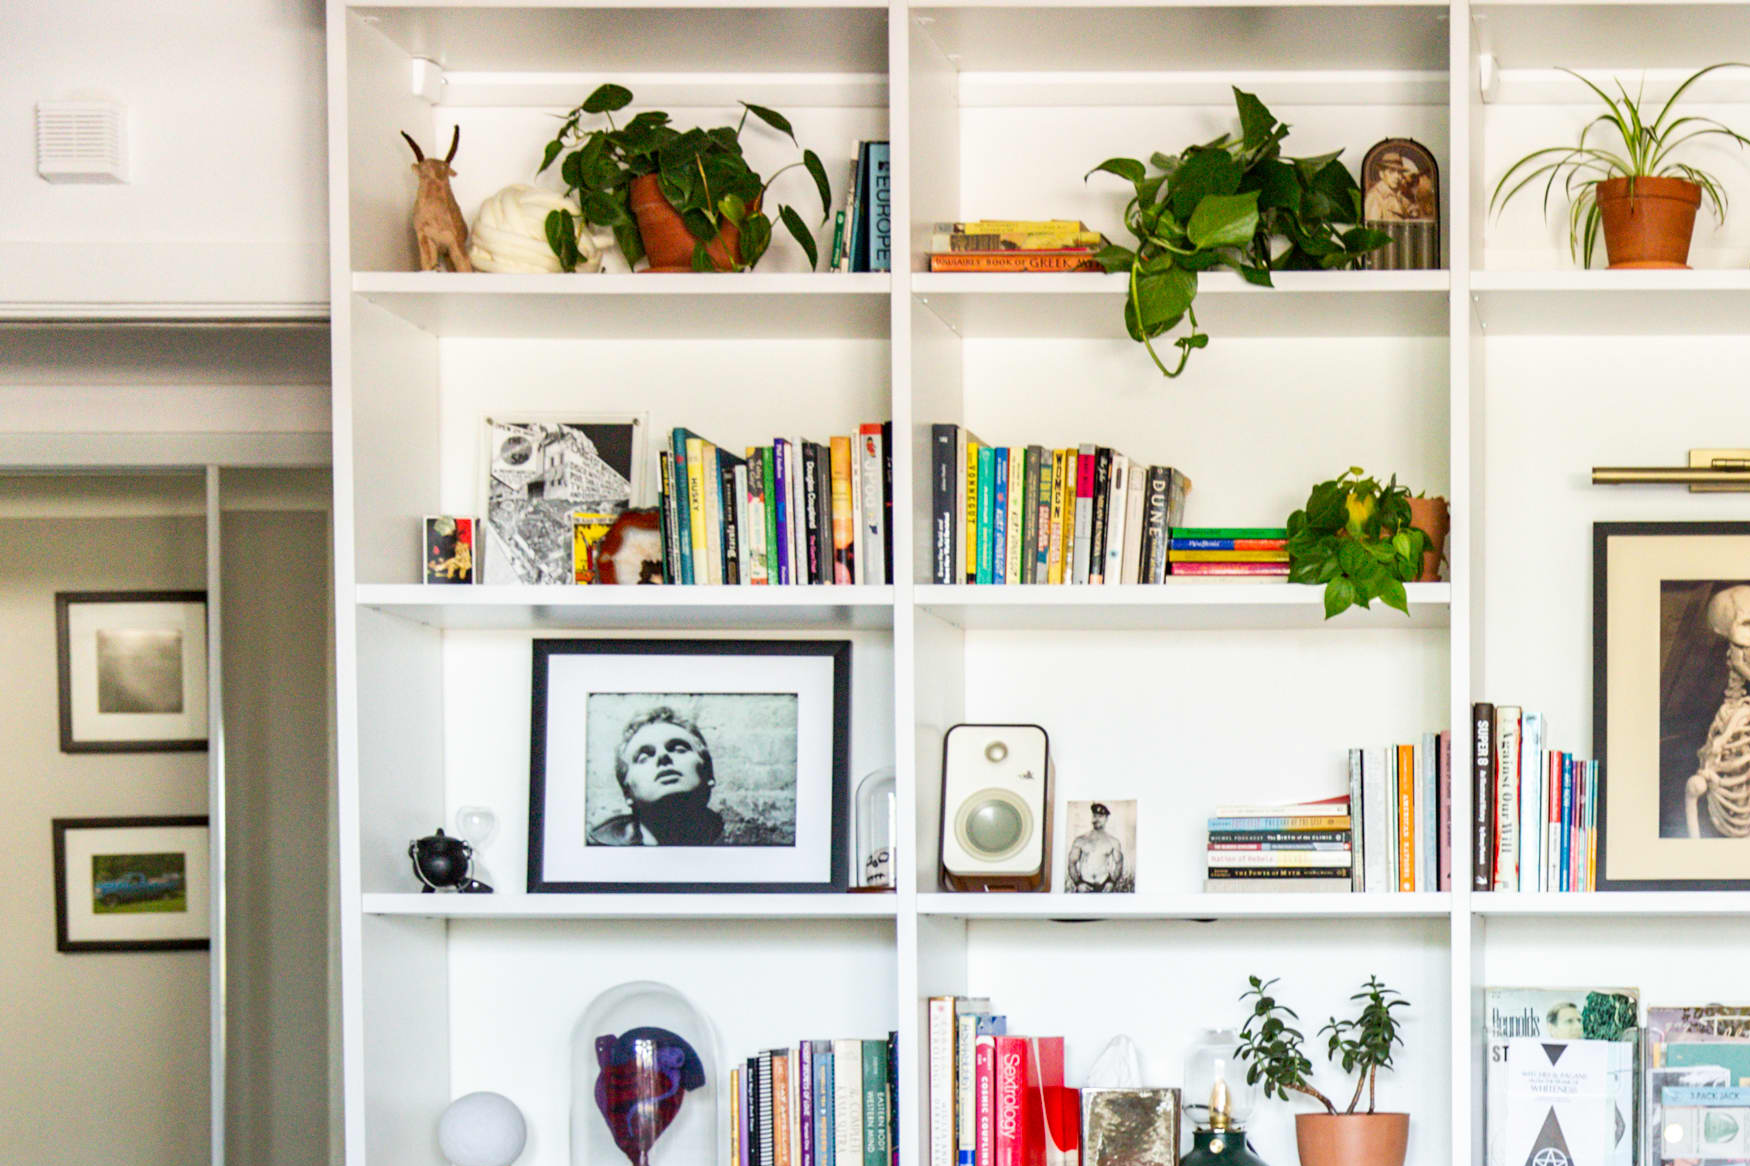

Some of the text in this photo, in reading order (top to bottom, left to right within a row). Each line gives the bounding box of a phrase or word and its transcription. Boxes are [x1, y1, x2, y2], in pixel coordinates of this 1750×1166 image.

[876, 174, 891, 262] EUROPE
[1028, 256, 1071, 269] GREEK
[690, 477, 700, 512] HUSKY
[805, 460, 816, 492] Douglas
[967, 464, 976, 525] VONNEGUT
[1054, 453, 1063, 519] WOMEN
[1149, 479, 1167, 537] DUNE
[1476, 719, 1490, 757] SUPER
[1496, 731, 1515, 854] Against Our Will
[866, 1091, 876, 1153] WESTERN MIND
[876, 1091, 886, 1153] EASTERN BODY
[980, 1075, 990, 1166] COSMIC COUPLING
[999, 1052, 1020, 1140] Sextrology
